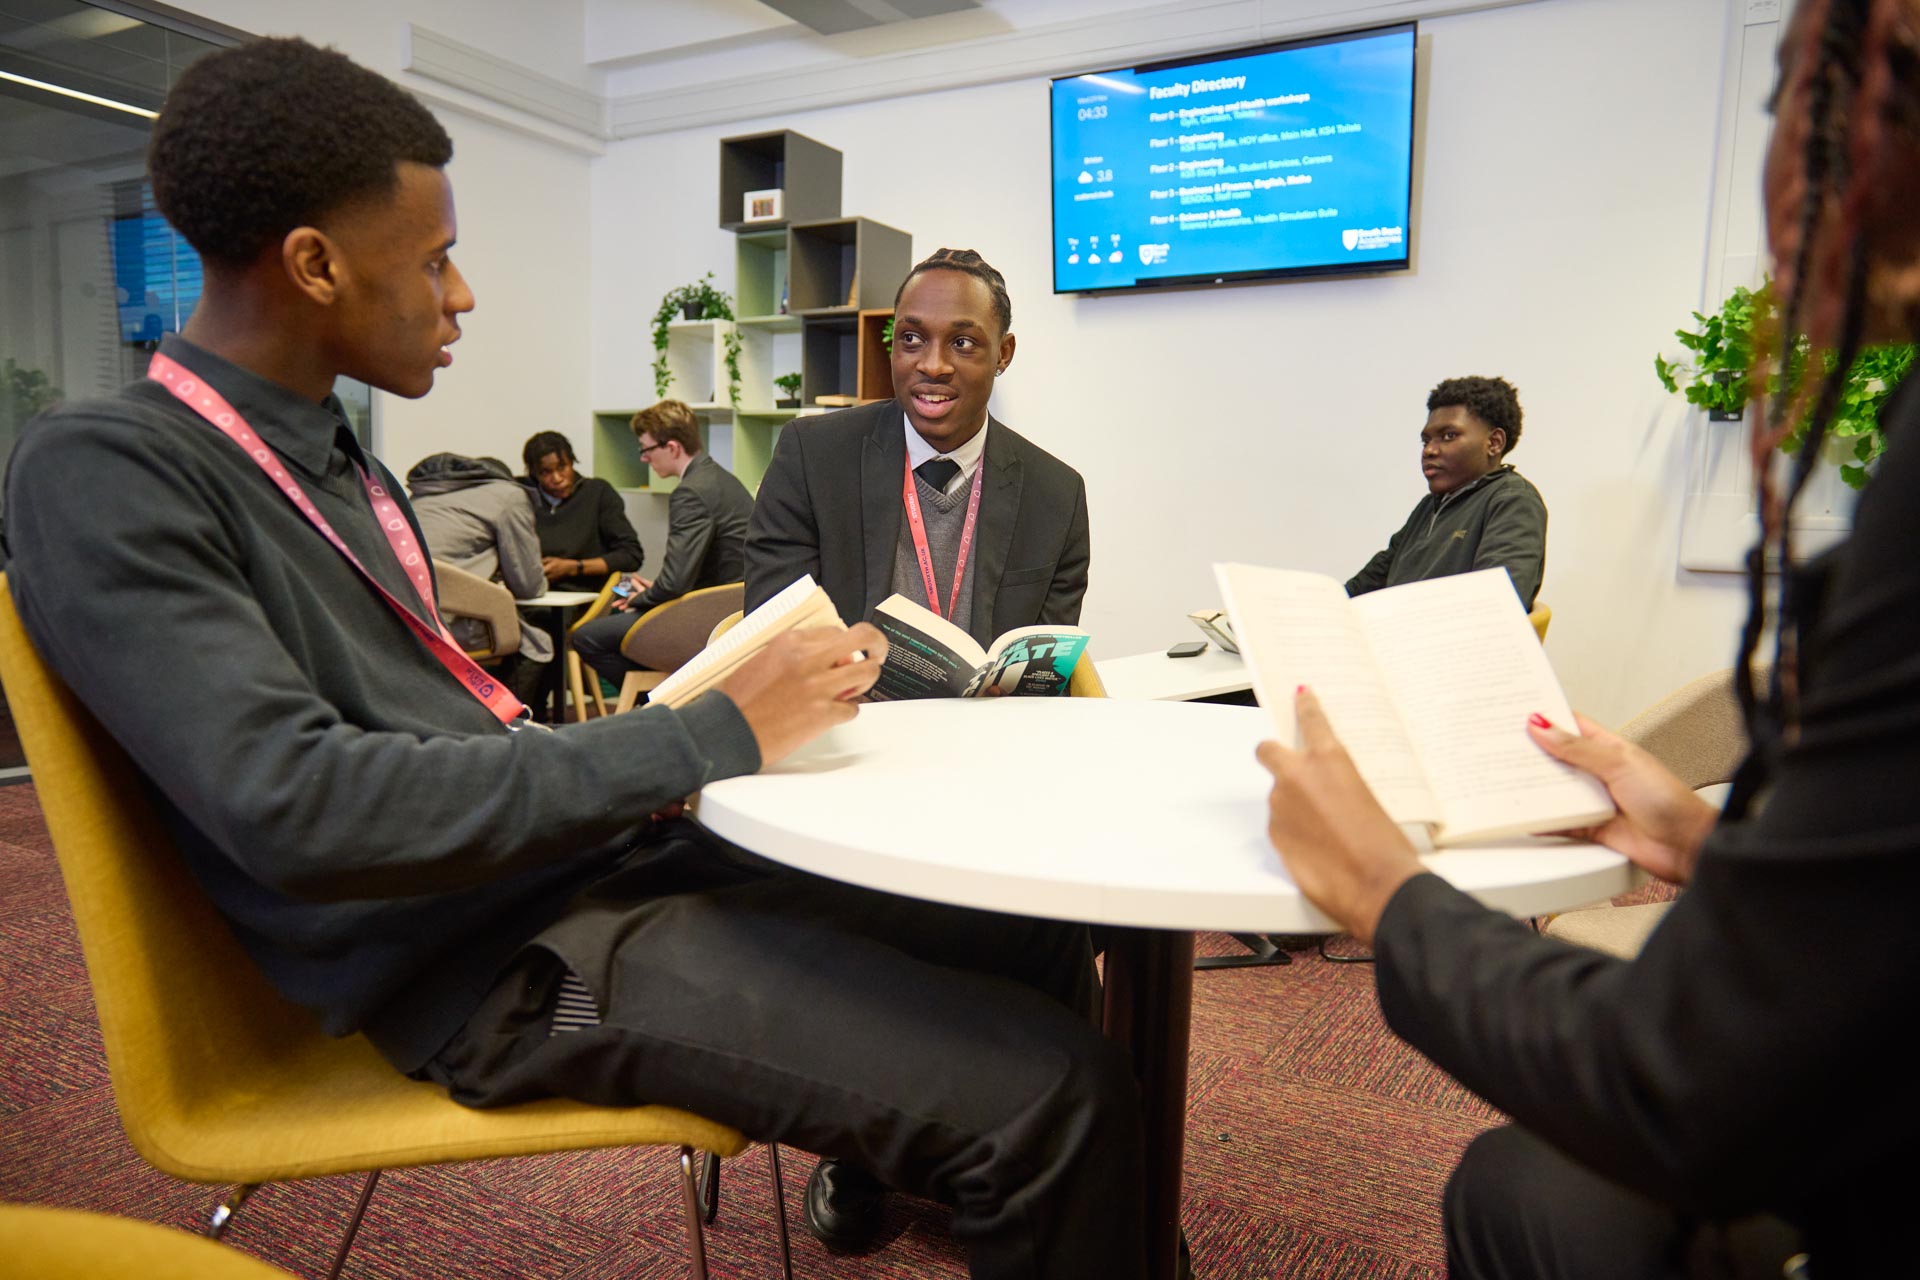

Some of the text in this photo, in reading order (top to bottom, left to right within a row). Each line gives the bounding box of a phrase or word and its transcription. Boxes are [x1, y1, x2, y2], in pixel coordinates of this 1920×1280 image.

[1150, 76, 1246, 100] Faculty Directory
[1150, 112, 1168, 122] Floor
[1179, 105, 1224, 118] Engineering
[1224, 101, 1240, 112] and
[1240, 98, 1265, 110] Health
[1266, 93, 1310, 107] workshops
[1150, 138, 1168, 148] Floor
[1168, 136, 1174, 146] 1
[1179, 132, 1224, 144] Engineering
[1280, 131, 1300, 140] Main
[1336, 123, 1362, 134] Toilets
[1150, 164, 1168, 174] Floor
[1168, 162, 1174, 172] 2
[1179, 158, 1224, 170] Engineering
[1239, 162, 1267, 173] Student
[1302, 154, 1333, 166] Careers
[1150, 190, 1168, 200] Floor
[1179, 186, 1214, 196] Business
[1214, 183, 1220, 193] &
[1220, 182, 1254, 192] Finance,
[1254, 176, 1286, 190] English,
[1150, 215, 1168, 225] Floor
[1179, 212, 1208, 222] Science
[1208, 210, 1216, 220] &
[1216, 208, 1242, 219] Health
[1254, 213, 1278, 224] Health
[1278, 210, 1318, 222] Simulation
[1318, 208, 1338, 218] Suite
[908, 492, 918, 520] STUDENT
